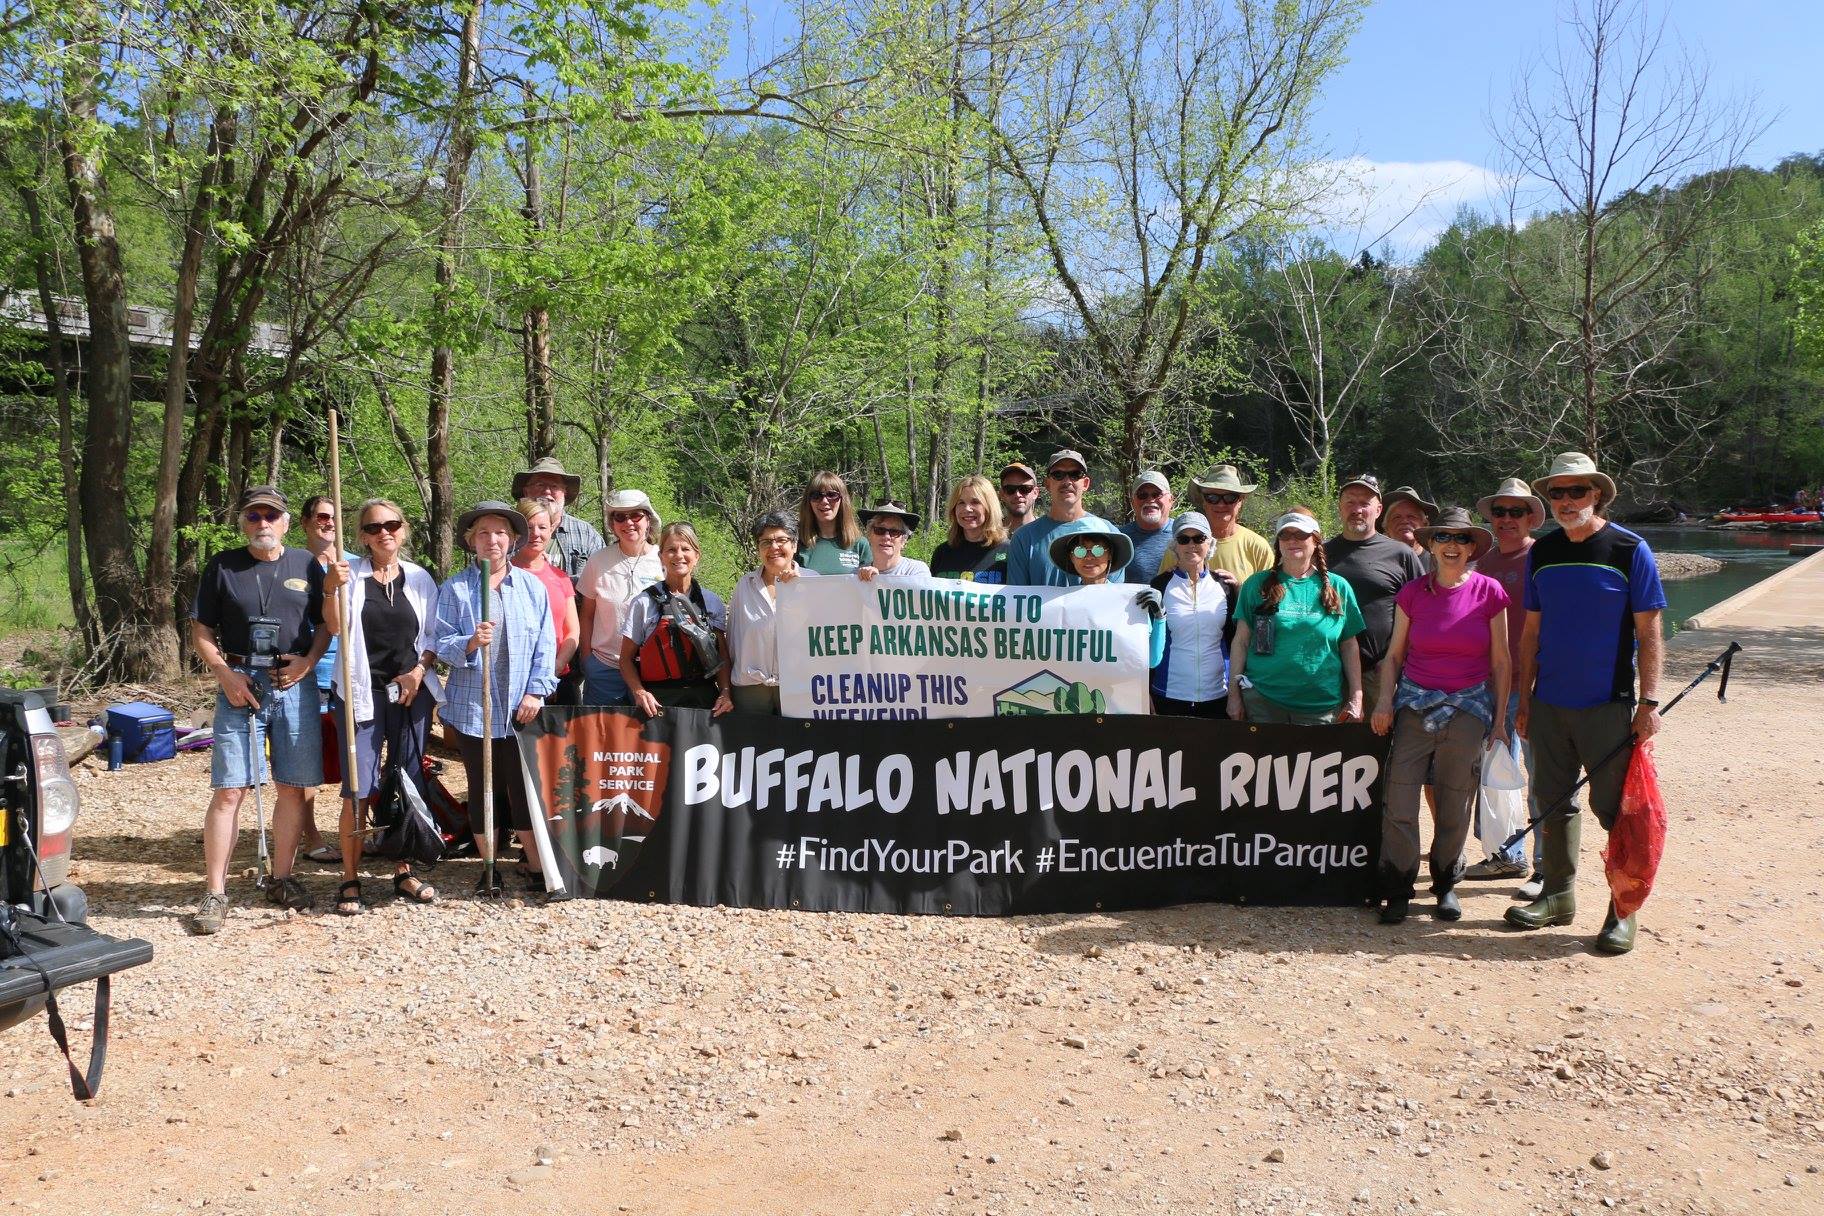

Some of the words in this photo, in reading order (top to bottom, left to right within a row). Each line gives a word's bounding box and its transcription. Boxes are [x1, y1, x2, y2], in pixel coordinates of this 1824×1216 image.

[878, 588, 1006, 621] VOLUNTEER
[1014, 595, 1042, 623] TO
[808, 625, 864, 657] KEEP
[869, 626, 988, 659] ARKANSAS
[994, 628, 1118, 662] BEAUTIFUL
[811, 674, 912, 705] CLEANUP
[917, 674, 969, 706] THIS
[593, 751, 661, 764] NATIONAL
[609, 766, 644, 777] PARK
[598, 779, 654, 791] SERVICE
[684, 744, 914, 814] BUFFALO
[935, 748, 1196, 815] NATIONAL
[1220, 751, 1378, 813] RIVER
[776, 836, 1025, 874] #FindYourPark
[1036, 833, 1368, 874] #EncuentraTuParque
